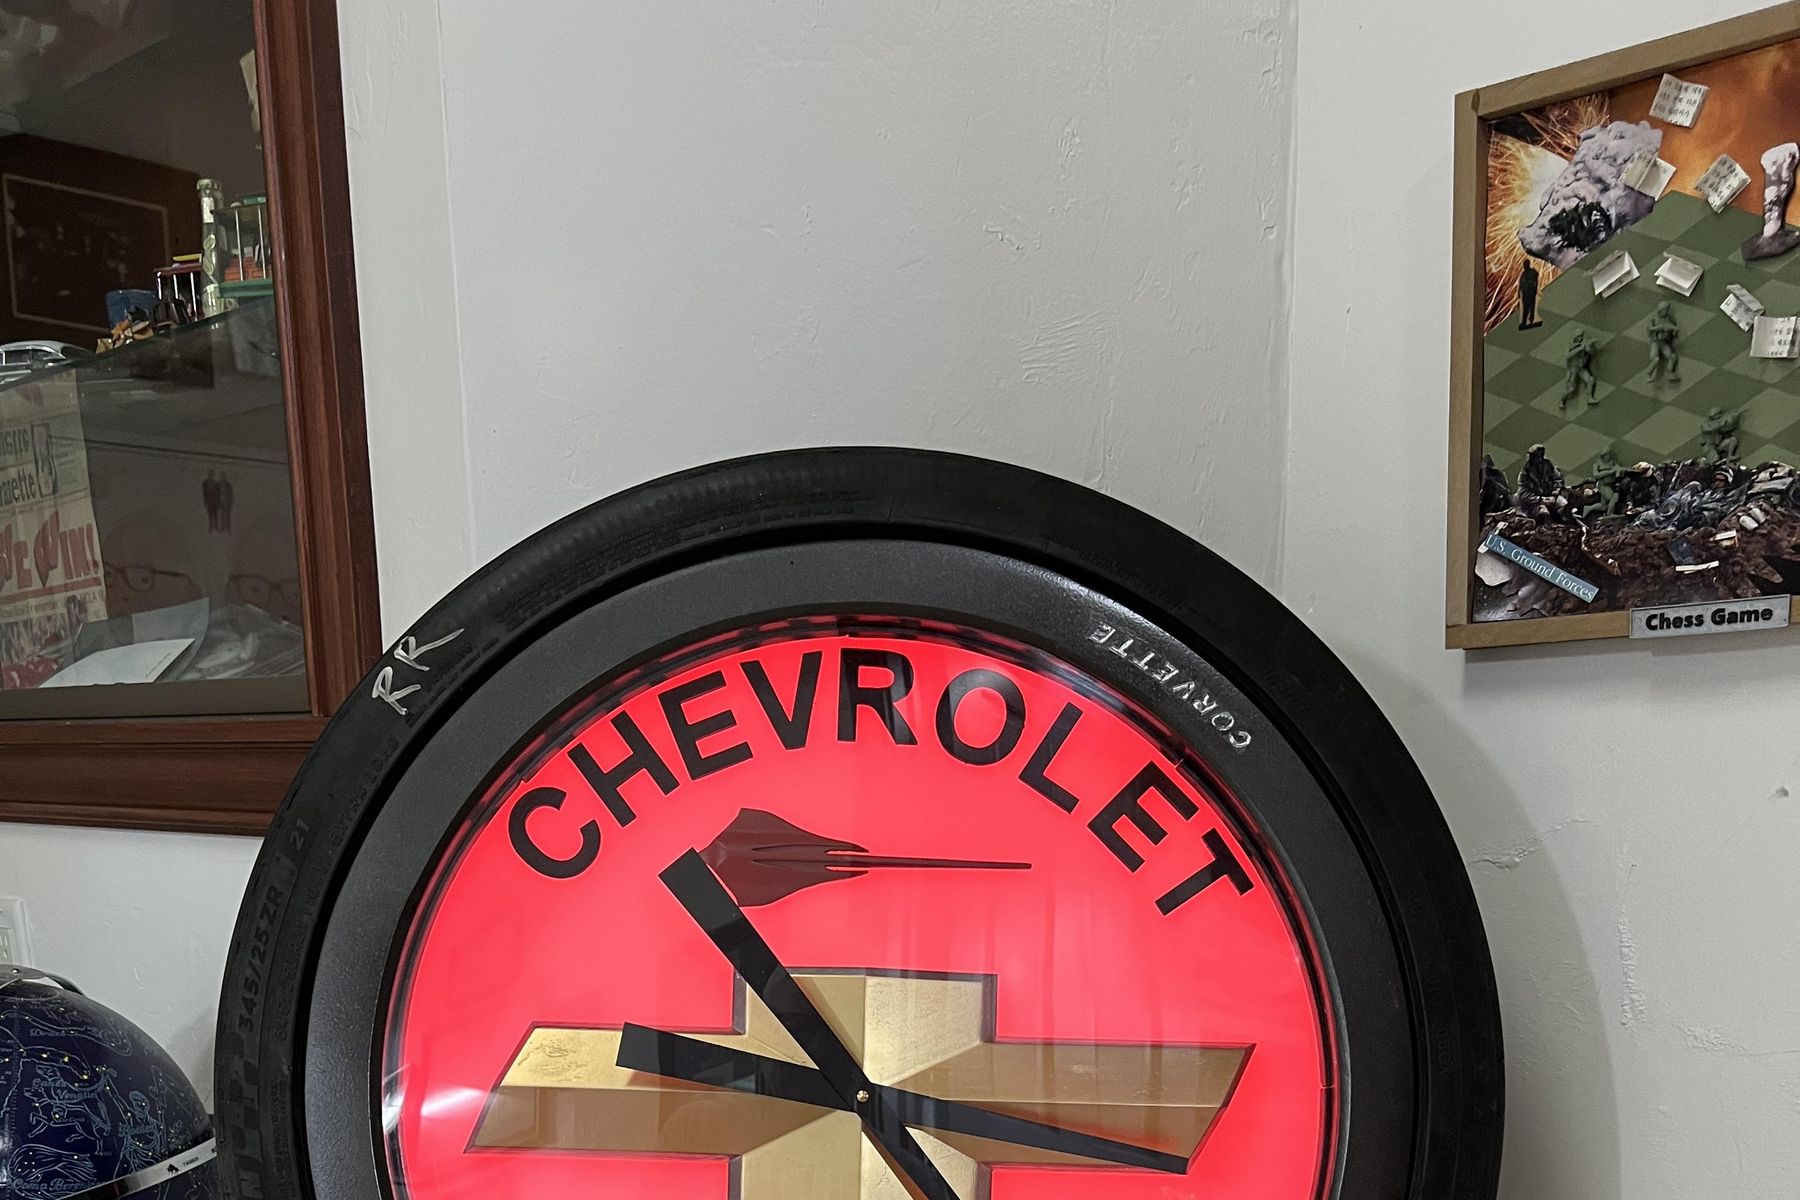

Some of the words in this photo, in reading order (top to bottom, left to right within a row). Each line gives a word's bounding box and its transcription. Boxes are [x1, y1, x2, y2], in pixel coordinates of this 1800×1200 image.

[1486, 534, 1508, 555] U.S.
[1511, 548, 1555, 578] Ground
[1555, 572, 1593, 602] Forces
[1645, 612, 1704, 631] Chess
[1710, 607, 1774, 626] Game
[372, 627, 465, 716] RR
[1088, 621, 1252, 748] CORVETTE
[506, 646, 1255, 916] CHEVROLET
